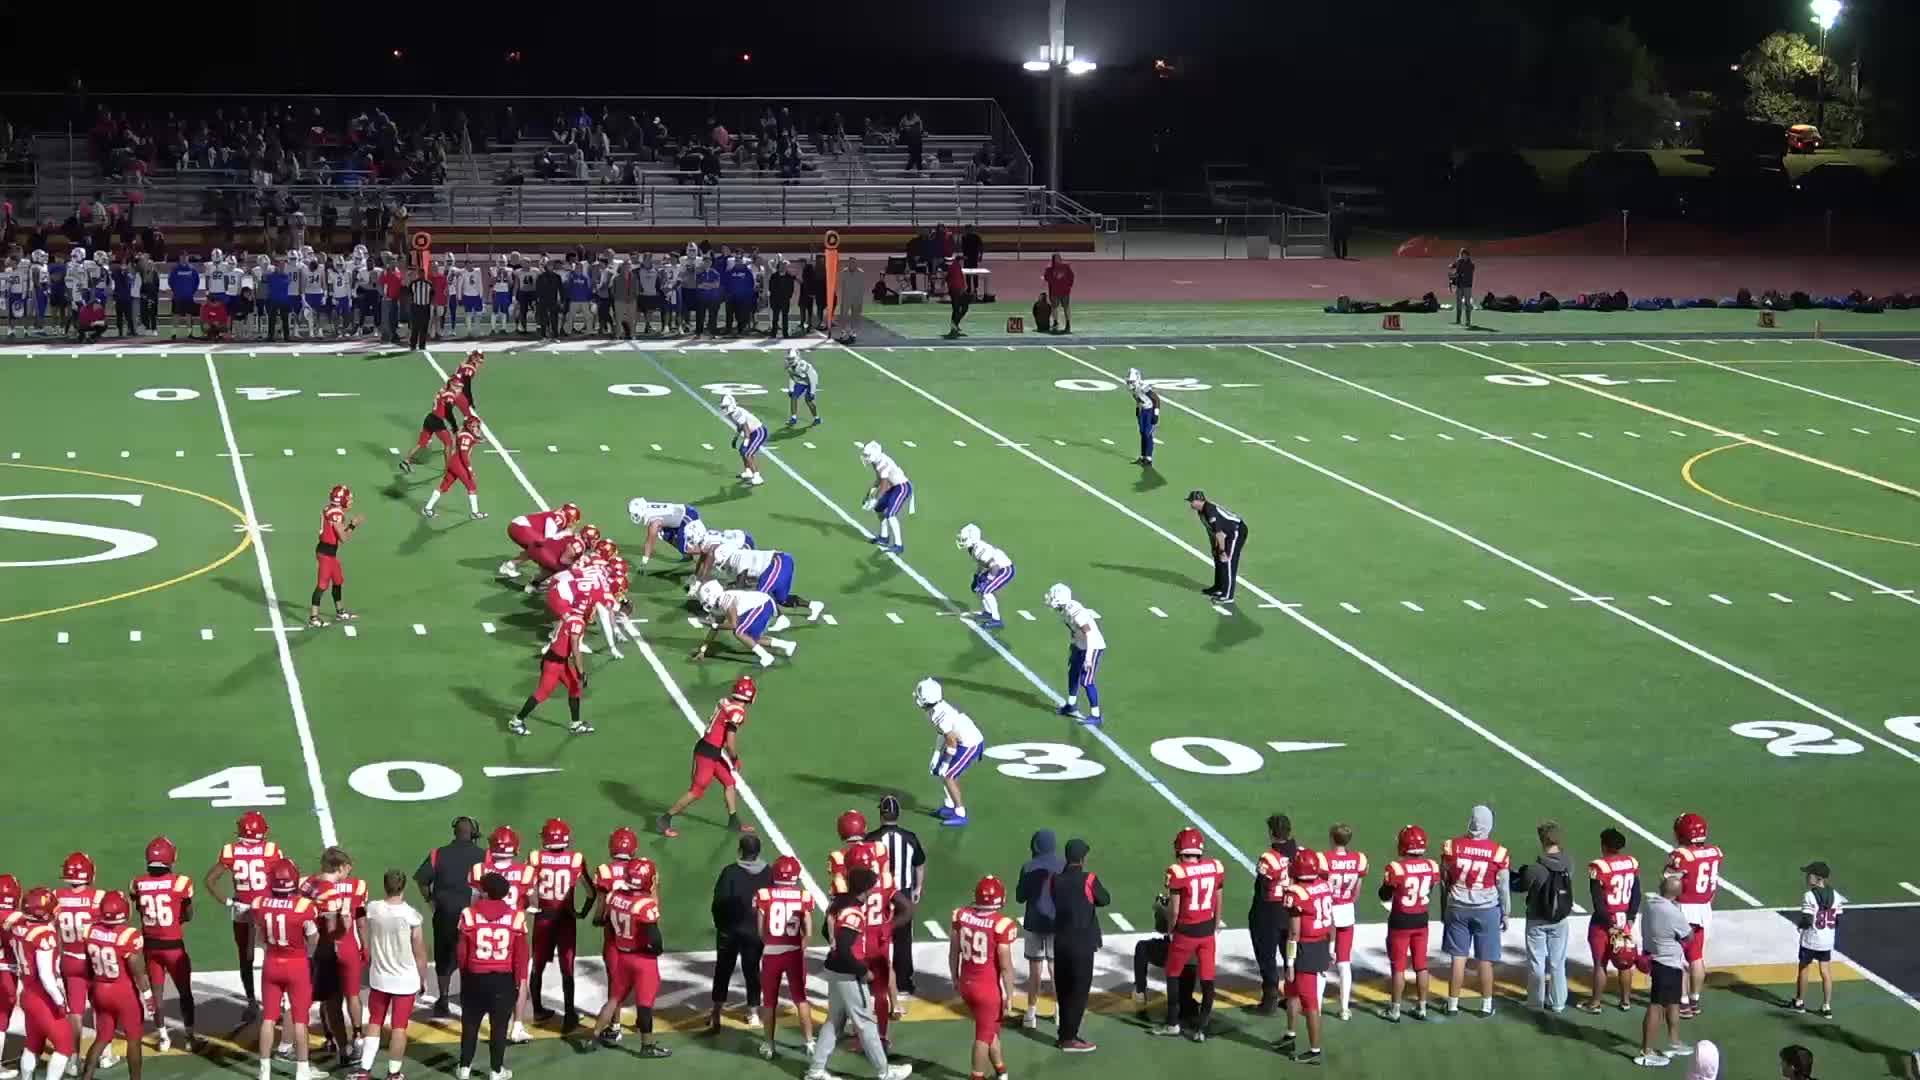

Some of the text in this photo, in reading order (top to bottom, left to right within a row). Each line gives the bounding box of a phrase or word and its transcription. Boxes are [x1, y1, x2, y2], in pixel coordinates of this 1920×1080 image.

[233, 859, 267, 891] 26
[539, 868, 571, 901] 20
[1456, 857, 1489, 888] 77
[1607, 872, 1635, 905] 30
[262, 897, 294, 909] GARCIA
[1188, 877, 1216, 911] 17
[1401, 875, 1432, 907] 34
[140, 893, 173, 927] 36
[769, 901, 801, 936] 85
[1313, 895, 1333, 929] 19
[1815, 909, 1837, 930] 85
[264, 912, 289, 946] 11
[960, 926, 988, 964] 69
